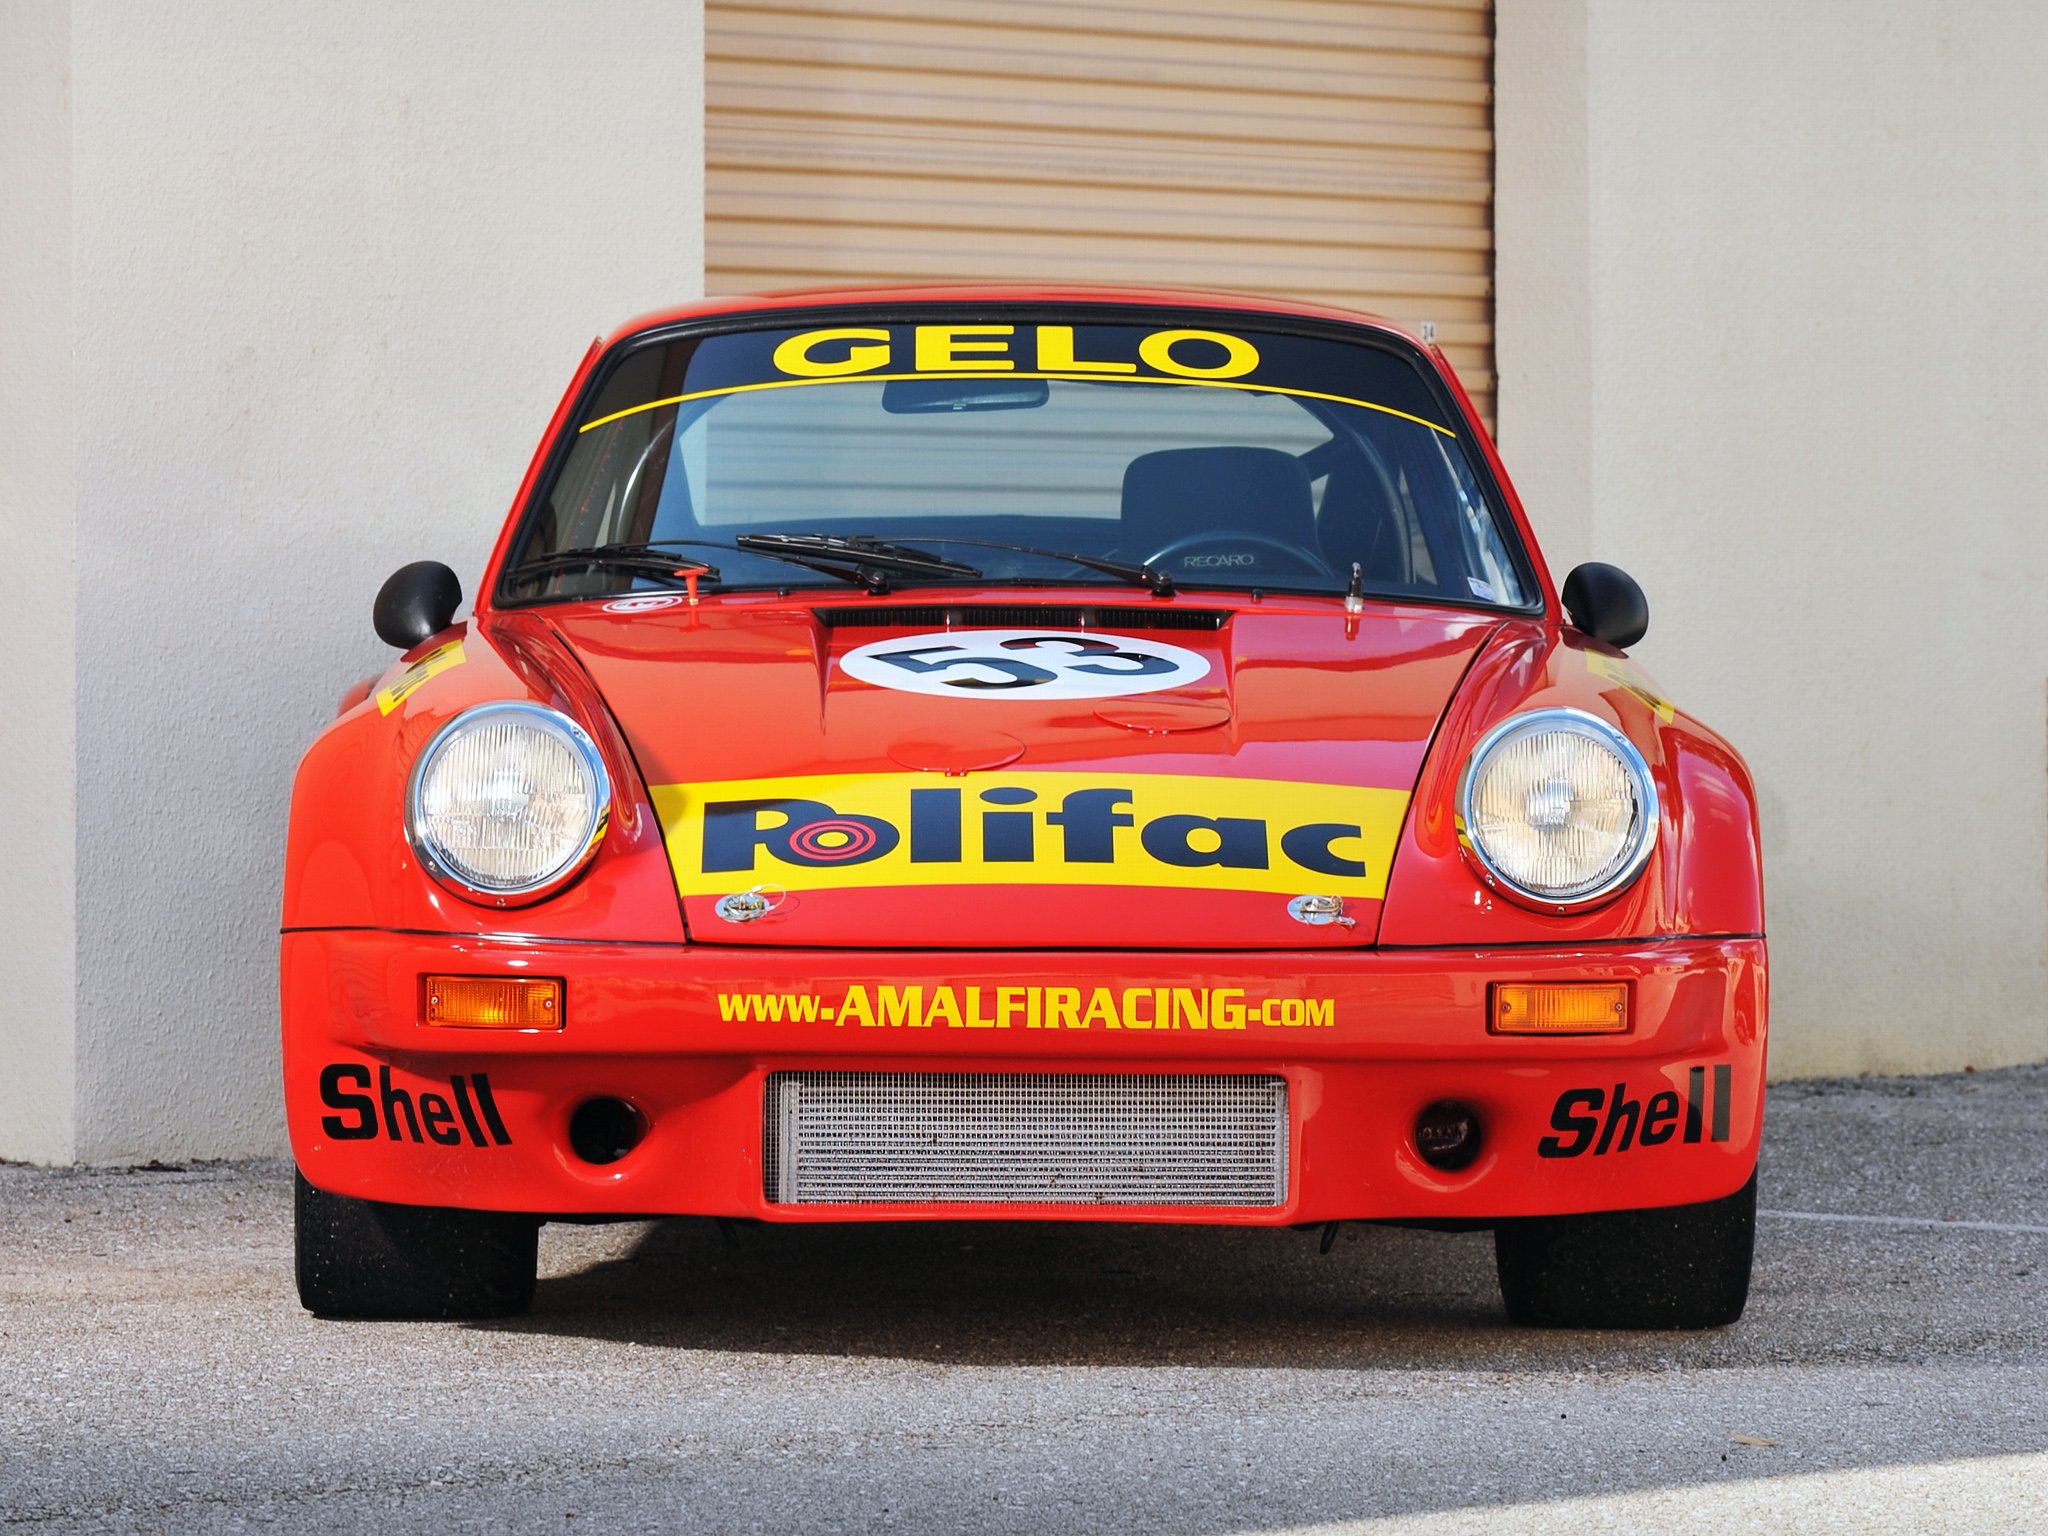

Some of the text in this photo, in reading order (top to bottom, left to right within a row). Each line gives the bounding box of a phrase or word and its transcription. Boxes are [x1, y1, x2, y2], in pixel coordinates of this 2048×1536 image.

[774, 325, 1259, 377] GELO
[1184, 554, 1254, 567] RECARO
[867, 637, 1180, 689] 53
[702, 787, 1366, 877] Polifac
[319, 1063, 512, 1147] Shell
[1538, 1064, 1731, 1158] Shell
